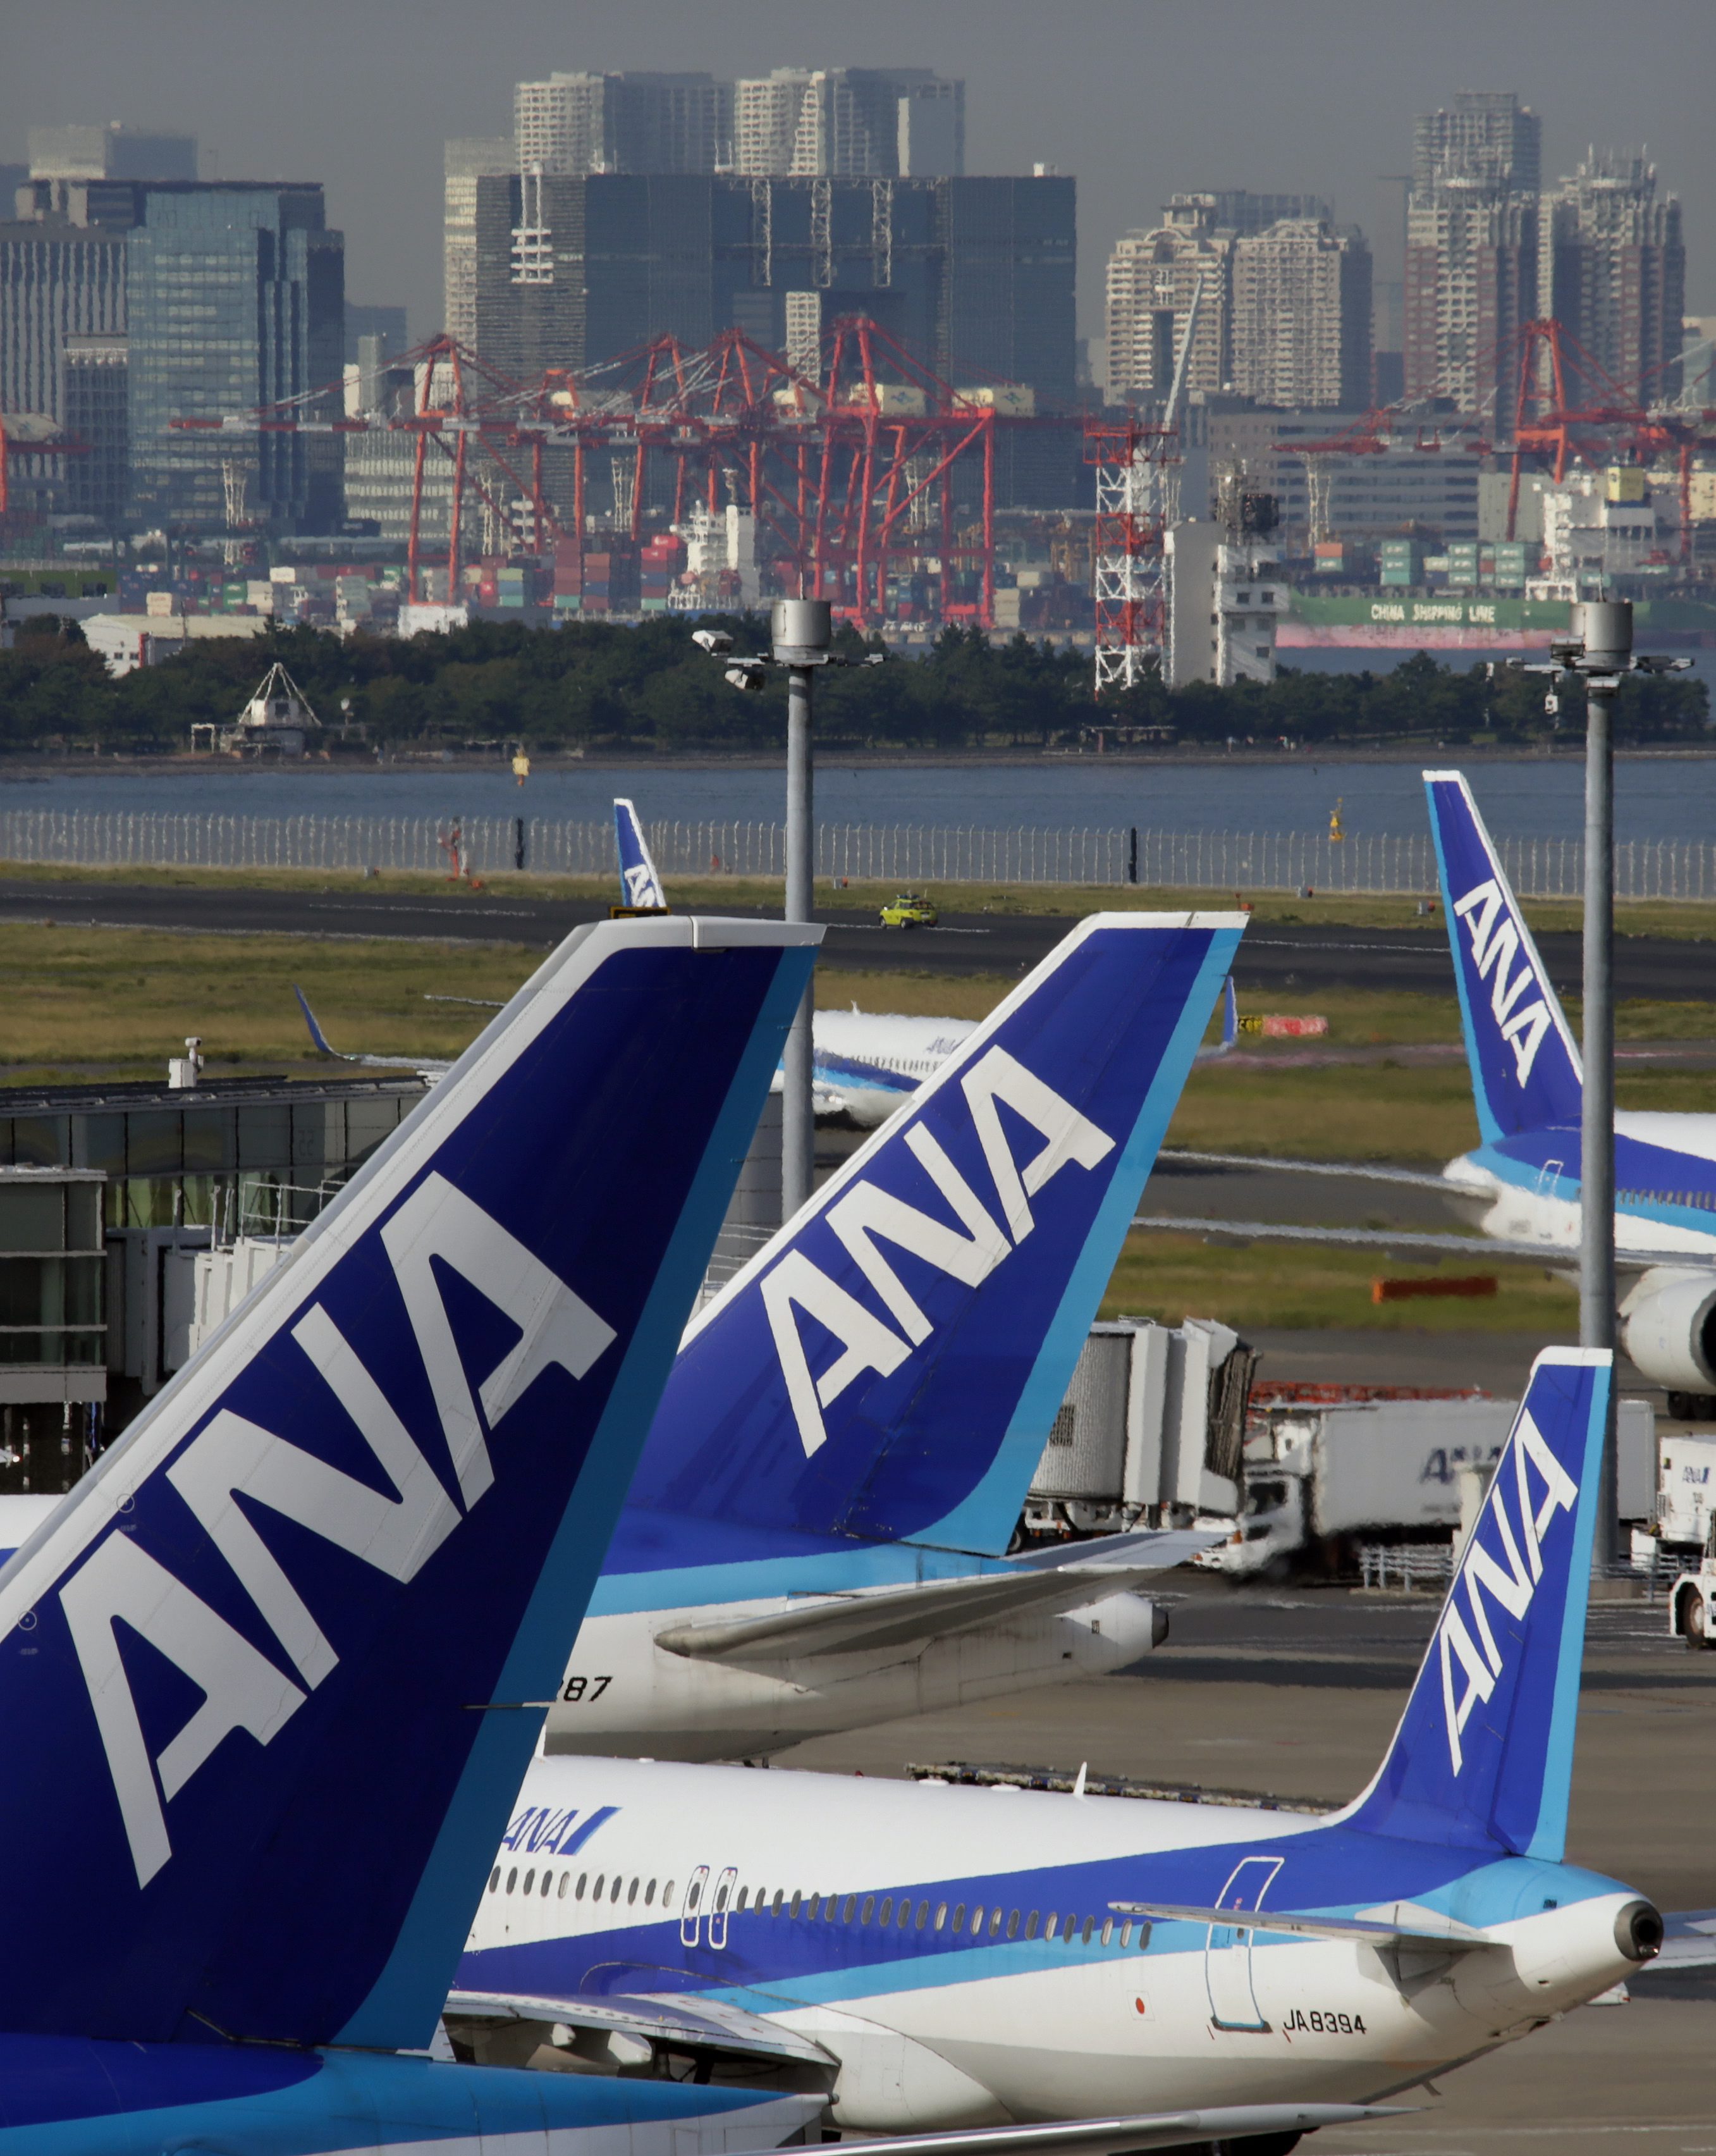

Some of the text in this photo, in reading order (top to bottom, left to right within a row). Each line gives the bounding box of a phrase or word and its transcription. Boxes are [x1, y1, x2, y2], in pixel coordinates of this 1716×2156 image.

[1371, 603, 1496, 623] CHINA SHIPPING LINE
[1454, 878, 1552, 1088] ANA
[759, 1044, 1116, 1458] ANA
[59, 1171, 616, 1889] ANA
[1440, 1408, 1578, 1777] ANA
[560, 1676, 613, 1701] 87
[502, 1807, 579, 1854] ANA
[1284, 2009, 1366, 2034] JA8394
